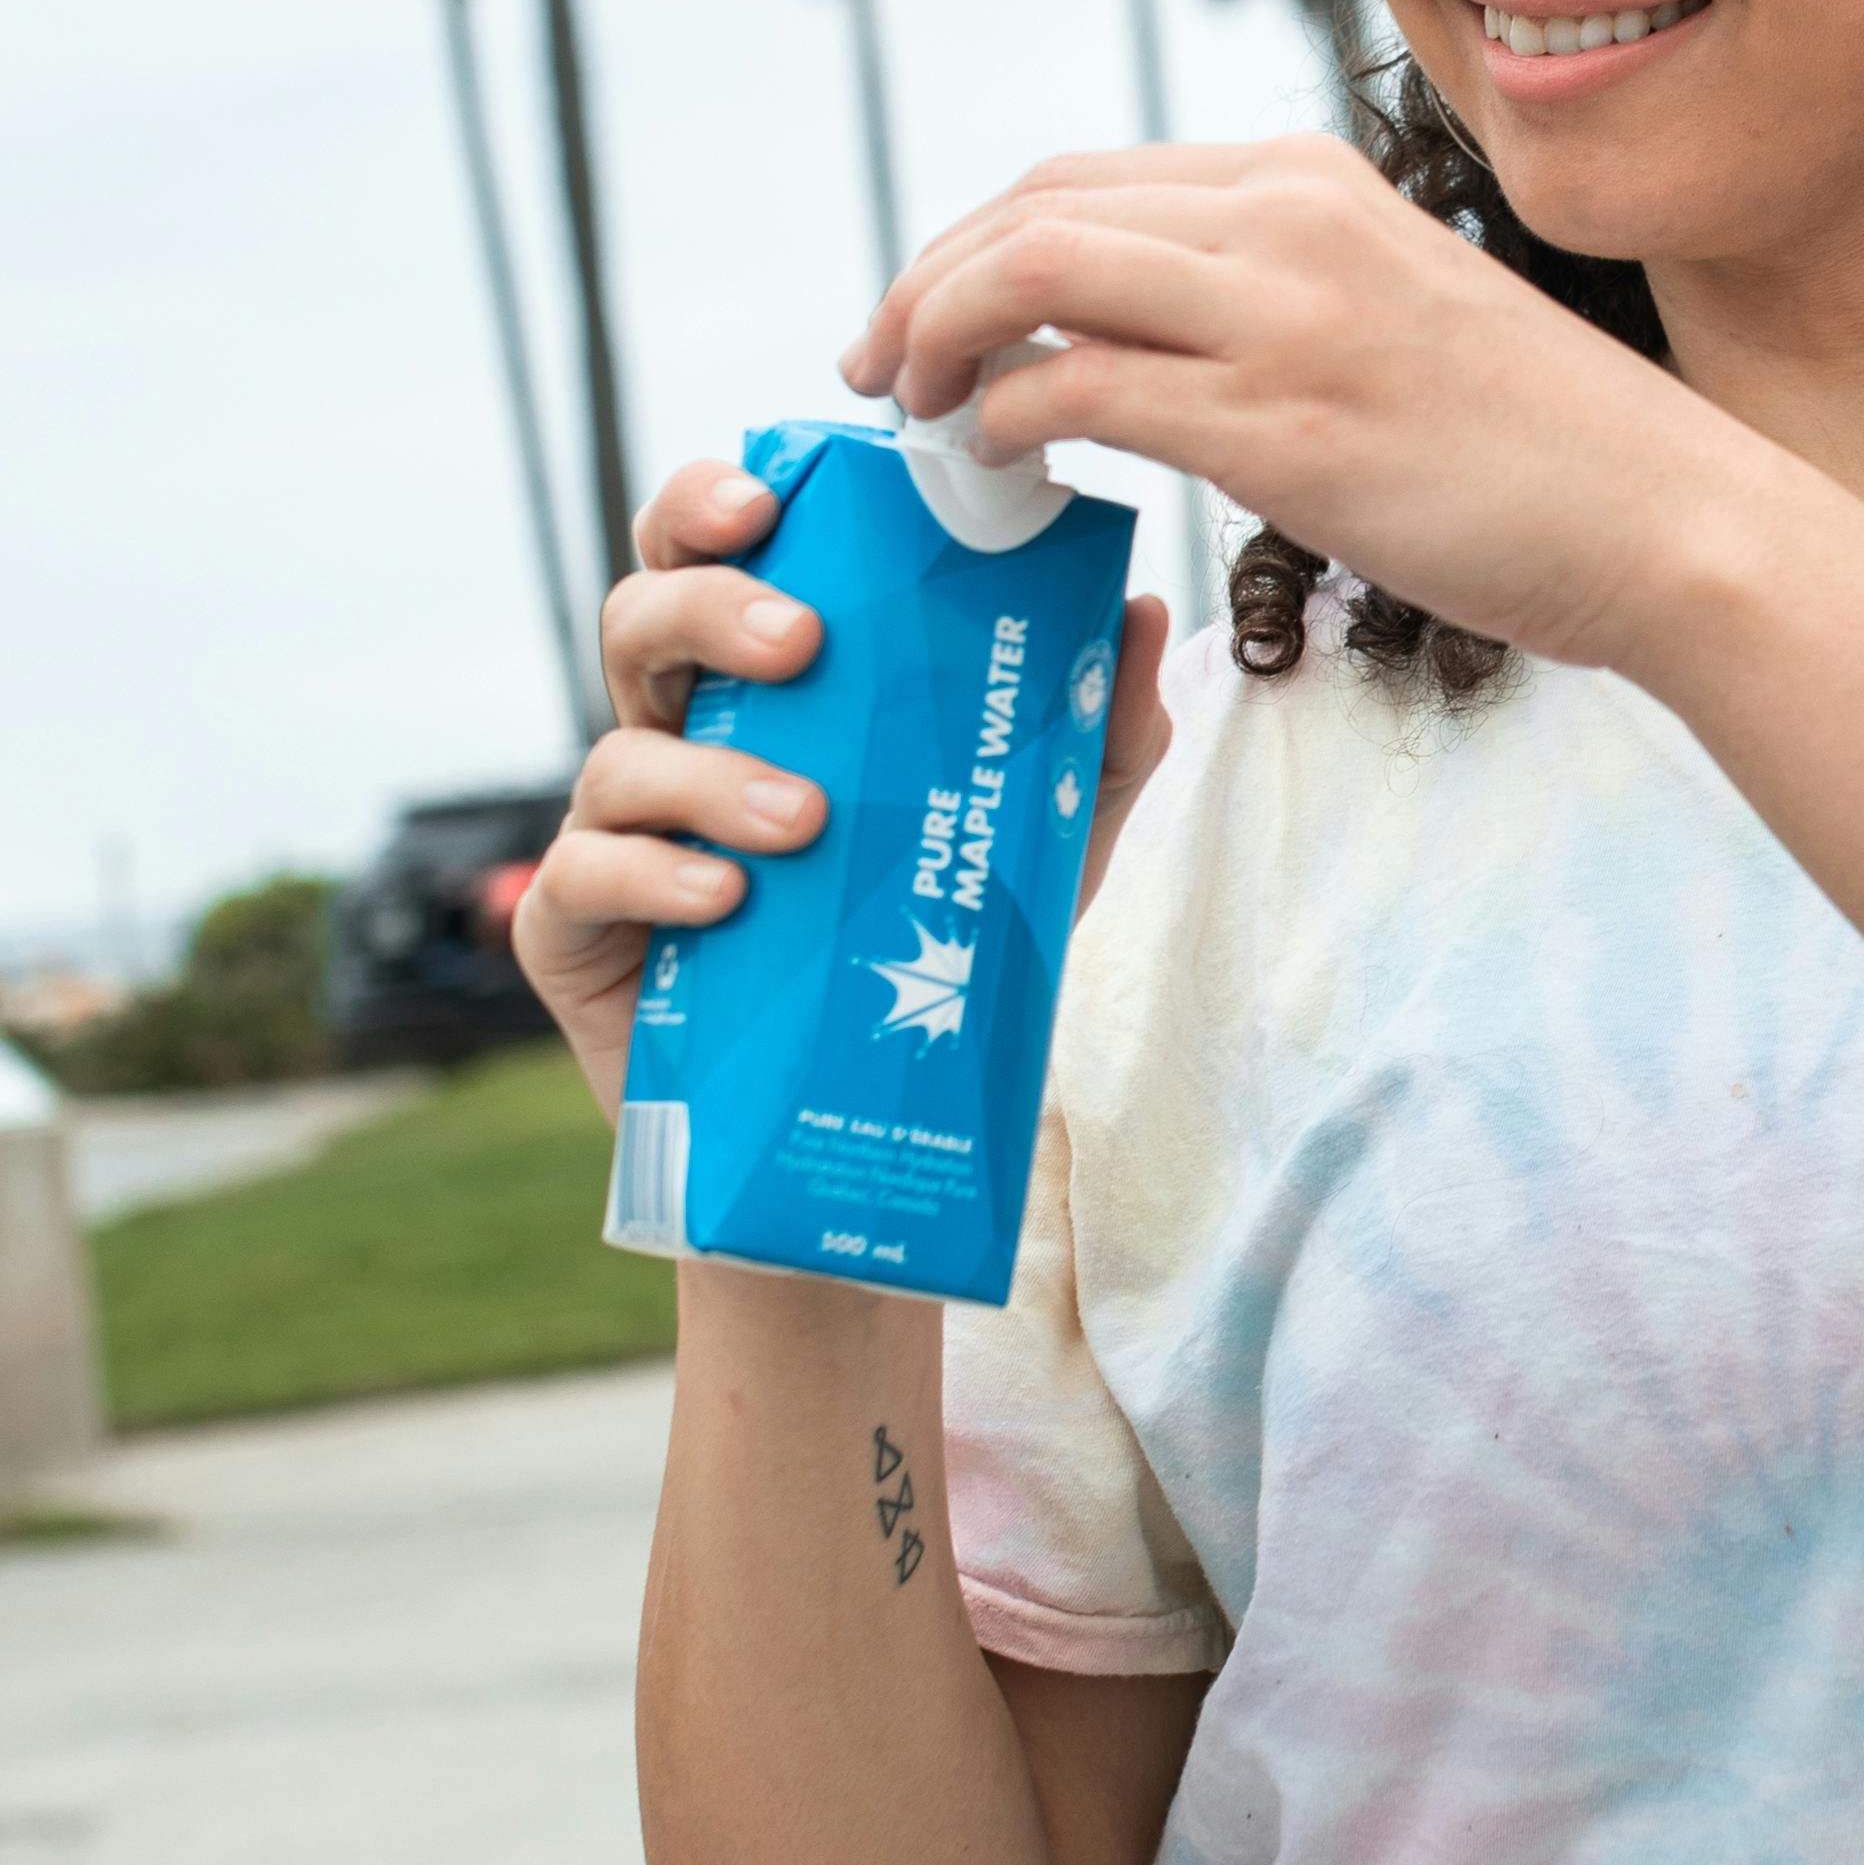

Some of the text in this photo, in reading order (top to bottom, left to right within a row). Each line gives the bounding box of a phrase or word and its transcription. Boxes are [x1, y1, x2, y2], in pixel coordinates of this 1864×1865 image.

[951, 615, 1029, 912] MAPLE WATER
[912, 787, 961, 899] PURE
[820, 1231, 868, 1257] 500
